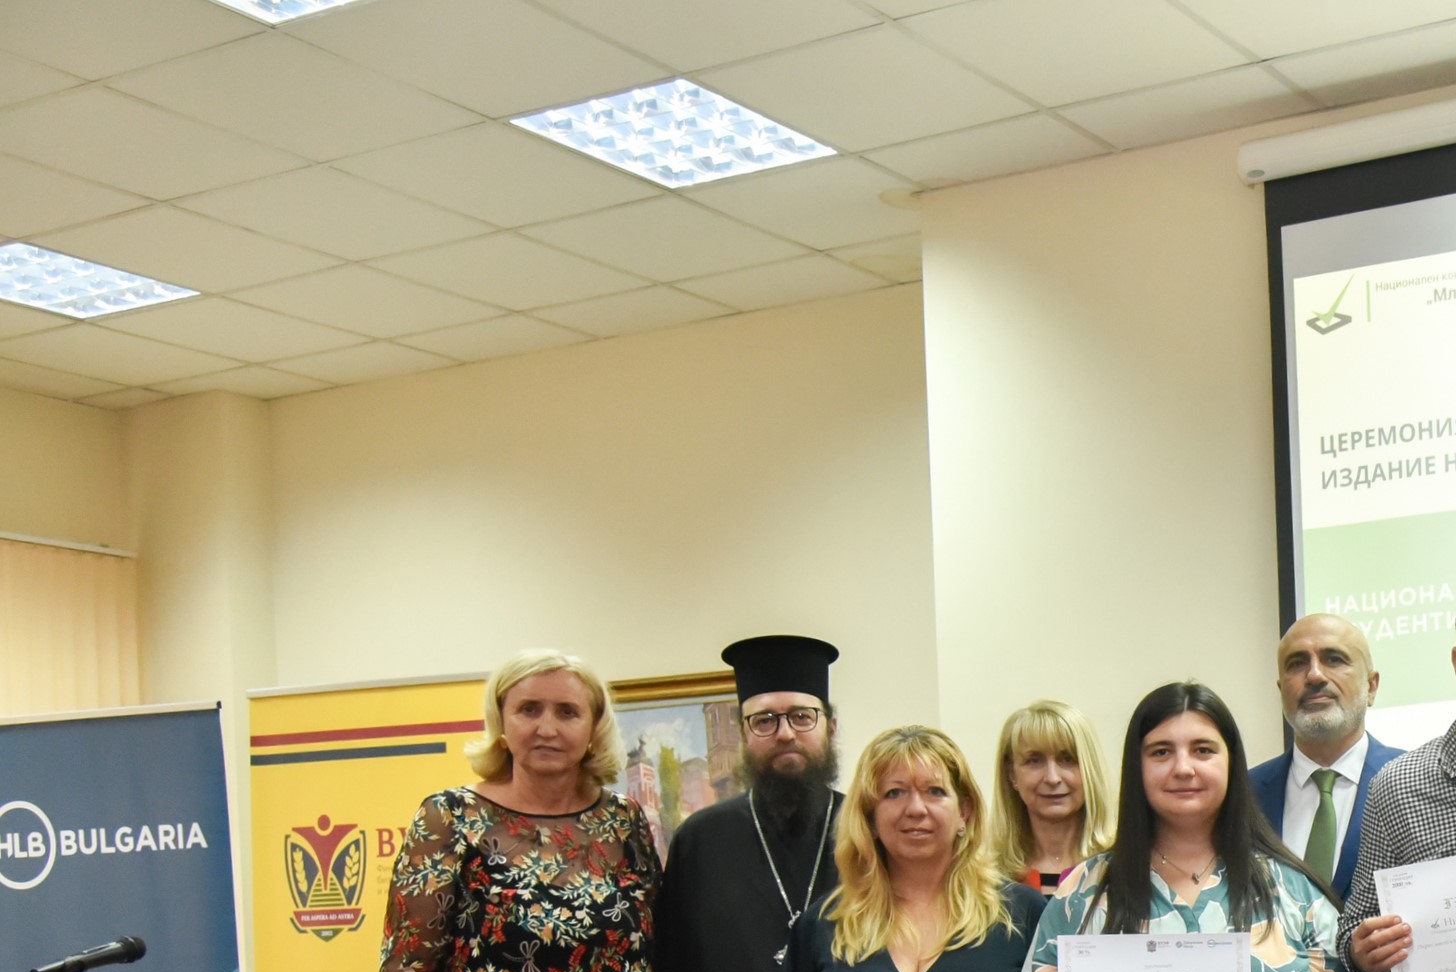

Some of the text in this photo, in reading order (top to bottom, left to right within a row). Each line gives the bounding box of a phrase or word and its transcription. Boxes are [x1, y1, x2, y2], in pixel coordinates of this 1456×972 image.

[1375, 274, 1439, 292] Национален
[1320, 454, 1437, 490] ИЗДАНИЕ
[60, 822, 208, 856] BULGARIA
